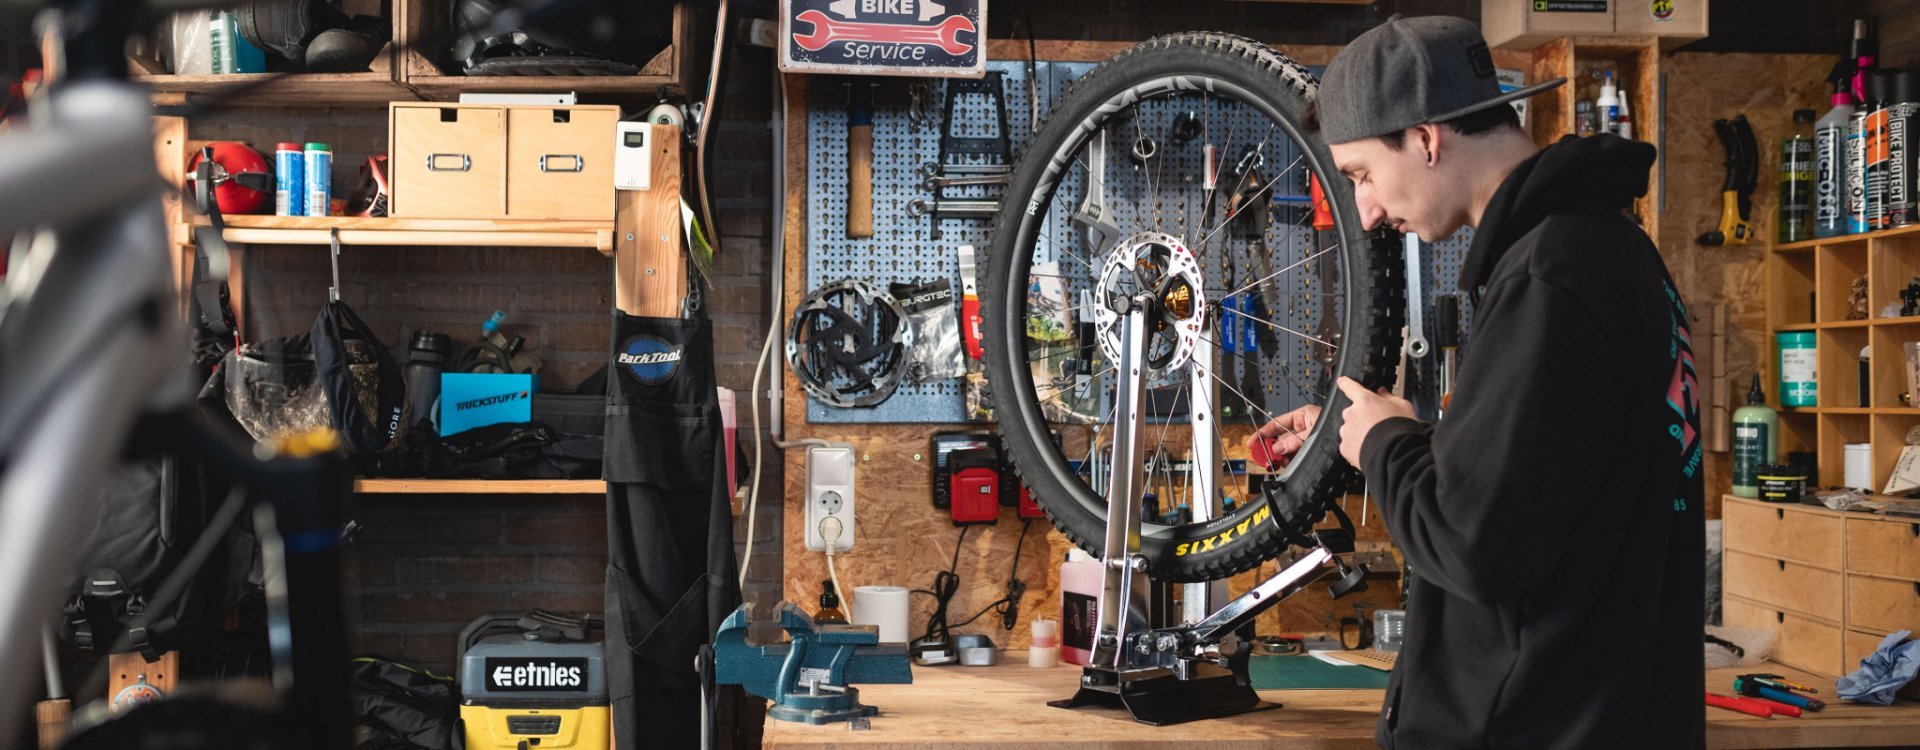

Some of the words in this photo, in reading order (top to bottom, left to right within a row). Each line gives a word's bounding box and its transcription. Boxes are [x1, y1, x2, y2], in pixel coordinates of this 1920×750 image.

[861, 0, 914, 15] BIKE
[843, 42, 925, 60] Service
[1890, 122, 1902, 148] BIKE
[1890, 150, 1903, 200] PROTECT
[902, 289, 952, 307] BURGTEC
[455, 392, 519, 411] TRICKSTUFF
[387, 406, 401, 439] GORE
[1175, 504, 1270, 557] MAXXIS
[514, 662, 581, 687] etnies
